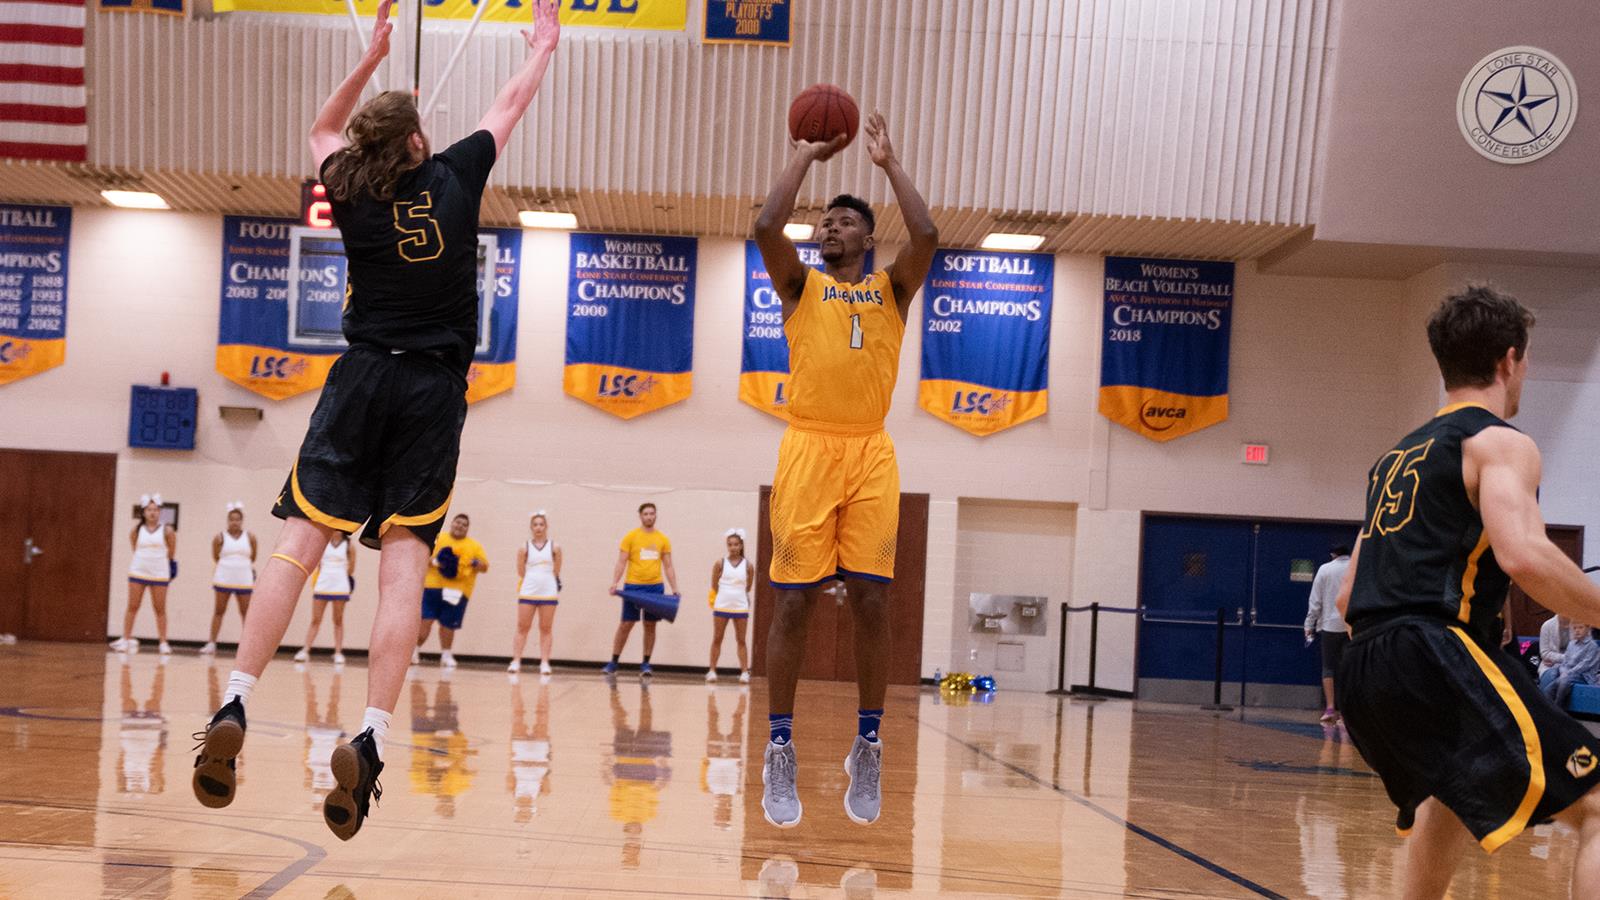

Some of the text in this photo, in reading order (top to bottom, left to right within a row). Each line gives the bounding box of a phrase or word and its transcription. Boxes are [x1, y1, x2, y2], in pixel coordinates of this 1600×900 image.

[726, 3, 772, 19] PLAYOFFS
[735, 19, 760, 34] 2000
[1486, 54, 1558, 78] LONE STAR
[1471, 127, 1556, 157] CONFERENCE
[240, 222, 291, 239] FOOT
[393, 191, 445, 262] 5
[604, 240, 662, 255] WOMEN'S
[575, 253, 689, 271] BASKETBALL
[944, 254, 1034, 275] SOFTBALL
[230, 261, 338, 287] CHAMONS
[1140, 264, 1199, 279] WOMEN'S
[265, 287, 289, 300] 200
[577, 280, 685, 305] CHAMPIONS
[932, 279, 1044, 292] LONE STAR CONFERENCE
[1105, 278, 1232, 296] BEACH VOLLEYBALL
[573, 304, 608, 317] 2000
[933, 295, 1041, 321] CHAMPIONS
[750, 312, 783, 325] 1995
[928, 319, 962, 333] 2002
[1113, 305, 1220, 330] CHAMPIONS
[749, 326, 782, 339] 2008
[849, 313, 864, 349] 1
[1109, 328, 1142, 342] 2018
[250, 356, 291, 377] LSC
[598, 374, 638, 397] LSC
[952, 390, 992, 415] LSC
[1144, 406, 1186, 419] avca
